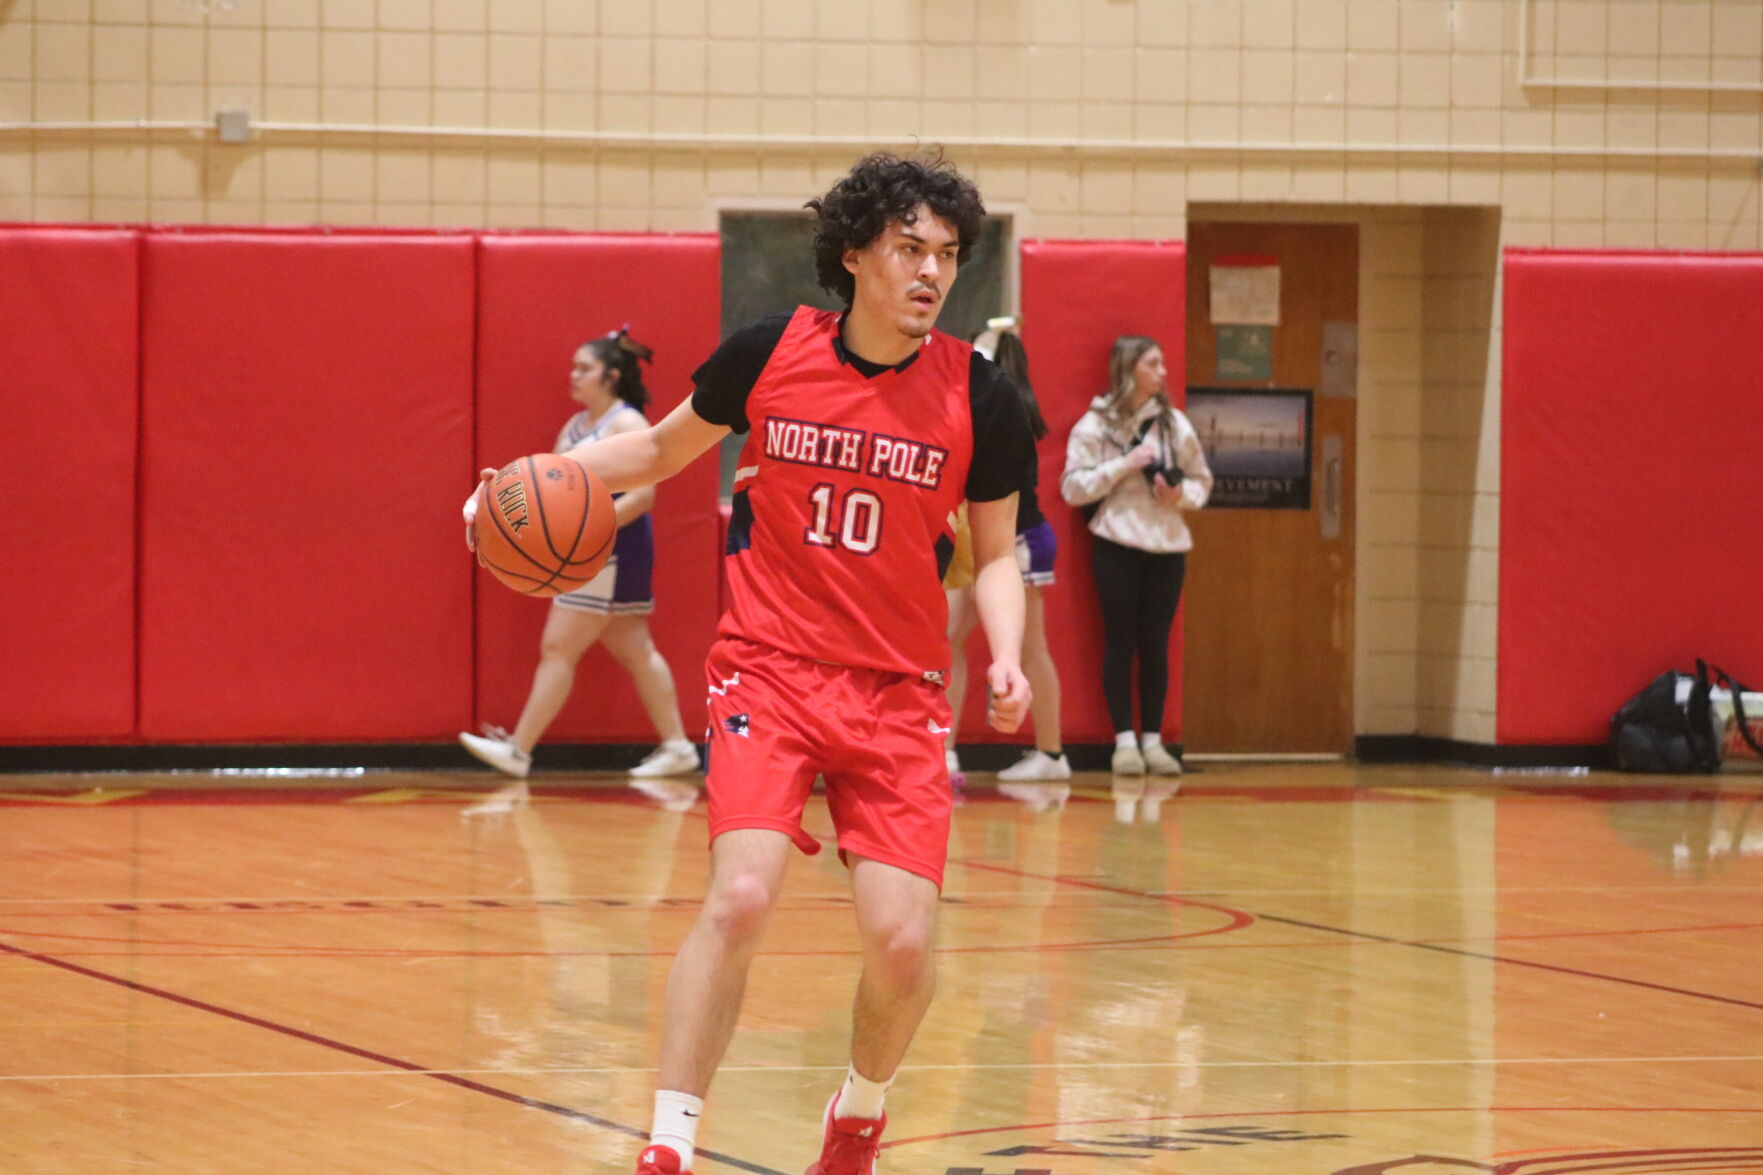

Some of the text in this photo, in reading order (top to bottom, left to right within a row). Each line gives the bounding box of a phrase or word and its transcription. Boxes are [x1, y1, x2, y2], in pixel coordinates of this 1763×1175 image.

[765, 416, 949, 491] NORTH POLE
[1213, 478, 1295, 492] EVEMENT
[496, 480, 529, 534] ROCK
[804, 482, 884, 556] 10
